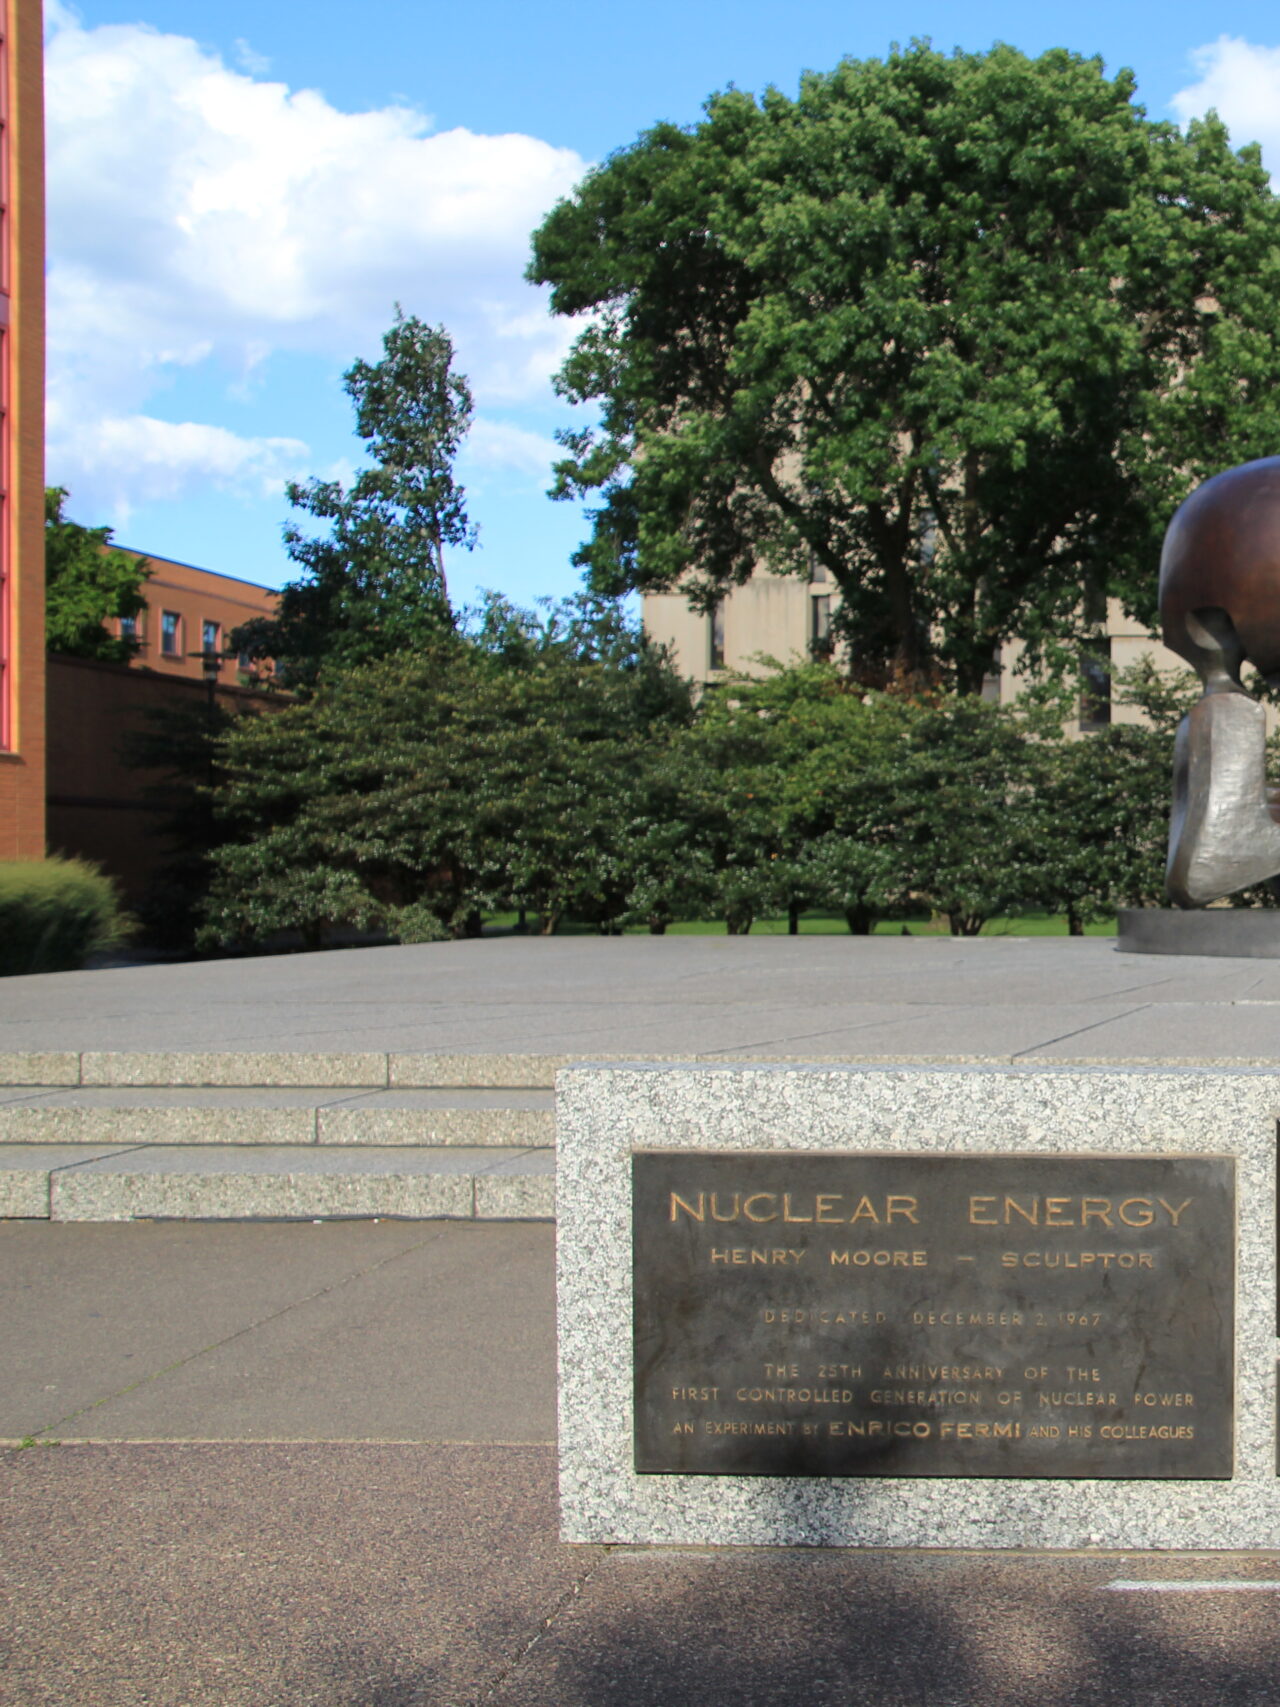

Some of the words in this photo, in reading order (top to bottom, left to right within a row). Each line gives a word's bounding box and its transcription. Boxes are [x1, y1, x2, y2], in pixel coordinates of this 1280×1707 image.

[670, 1192, 920, 1224] NUCLEAR
[969, 1196, 1193, 1227] ENERGY
[710, 1248, 805, 1265] HENRY
[830, 1251, 928, 1267] MOORE
[1001, 1252, 1153, 1268] SCULPTOR
[764, 1310, 886, 1324] DEDICATED
[913, 1312, 1023, 1326] DECEMBER
[1058, 1312, 1102, 1326] 1967
[764, 1363, 799, 1378] THE
[818, 1364, 862, 1379] 25TH
[883, 1364, 1004, 1381] ANNIVERSARY
[1024, 1367, 1049, 1381] OF
[1066, 1367, 1101, 1382] THE
[671, 1387, 719, 1402] FIRST
[736, 1388, 853, 1403] CONTROLLED
[870, 1389, 981, 1405] GENERATION
[997, 1391, 1022, 1405] OF
[1038, 1392, 1118, 1407] NUCLEAR
[1134, 1393, 1195, 1407] POWER
[673, 1422, 694, 1434] AN
[705, 1421, 794, 1436] EXPERIMENT
[829, 1420, 931, 1438] ENRICO
[940, 1422, 1021, 1439] FERMI
[1029, 1425, 1060, 1439] AND
[1068, 1425, 1092, 1439] HIS
[1100, 1425, 1195, 1440] COLLEAGUES
